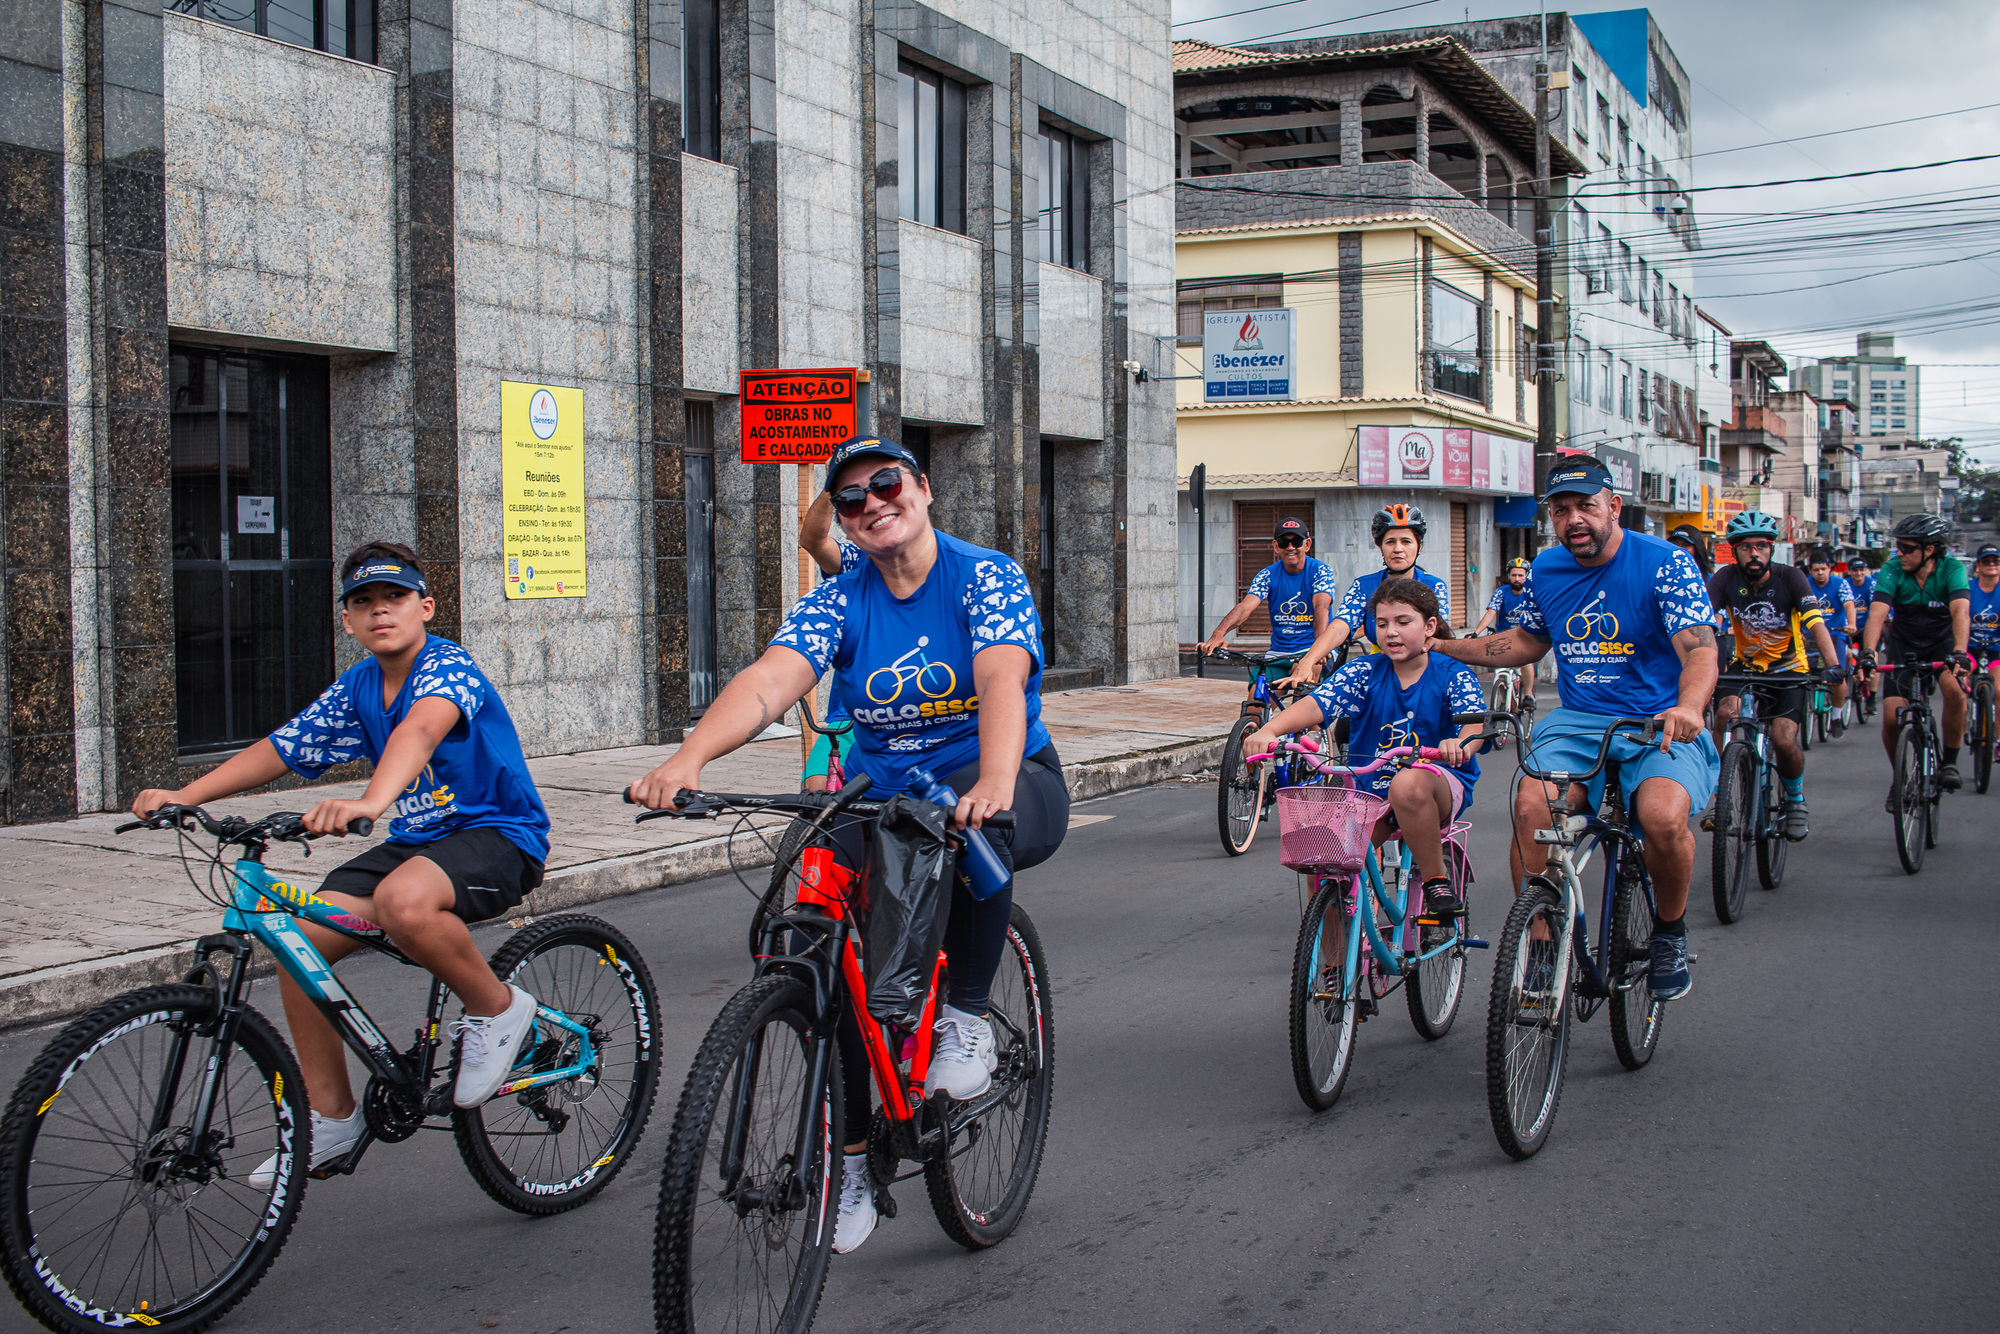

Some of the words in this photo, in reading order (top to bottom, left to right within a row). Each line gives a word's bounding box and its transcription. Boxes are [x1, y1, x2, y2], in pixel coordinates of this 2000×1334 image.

[1207, 316, 1242, 324] IGREJA
[1246, 314, 1286, 322] BATISTA
[1212, 352, 1284, 368] Ebenézer
[752, 379, 844, 398] ATENÇÃO
[764, 408, 809, 421] OBRAS
[814, 408, 832, 420] NO
[750, 425, 848, 438] ACOSTAMENTO
[758, 444, 766, 456] E
[1406, 441, 1426, 459] Ma
[526, 470, 560, 482] Reuniões
[1559, 641, 1635, 655] CICLOSESC
[853, 696, 979, 724] CICLOSESC
[898, 720, 922, 729] MAIS
[934, 713, 970, 724] CIDADE
[888, 736, 923, 750] Sesc
[276, 931, 388, 1049] GTS
